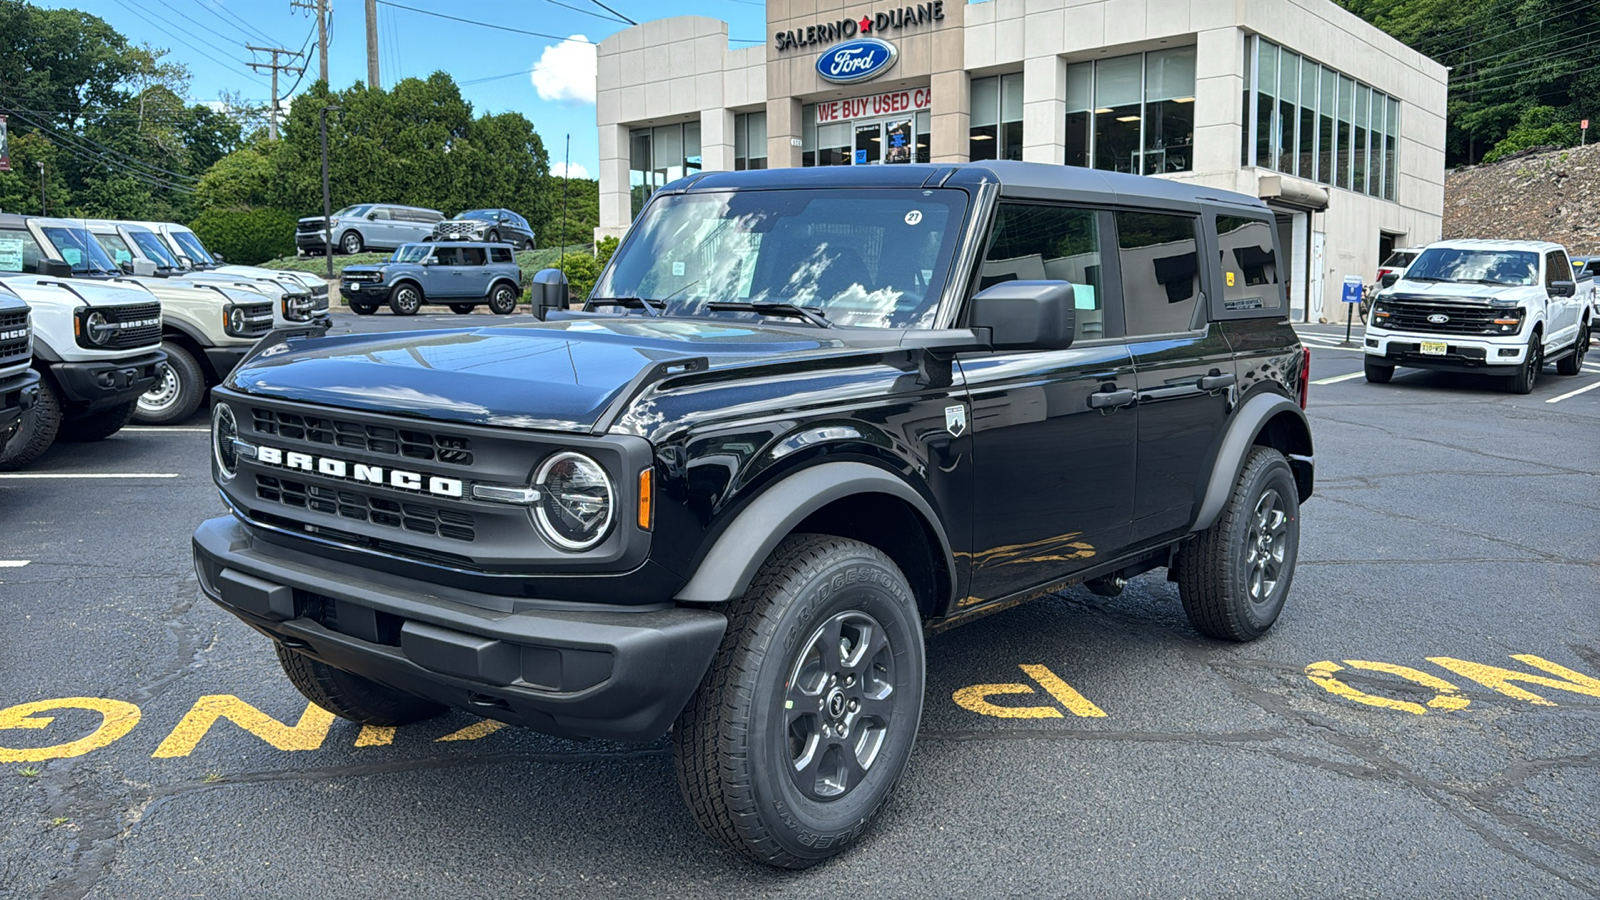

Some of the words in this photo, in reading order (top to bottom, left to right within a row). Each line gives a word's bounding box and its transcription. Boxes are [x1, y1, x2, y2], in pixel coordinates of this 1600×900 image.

[775, 18, 858, 50] SALERNO
[875, 0, 945, 31] DUANE
[830, 47, 874, 75] Ford
[818, 102, 838, 121] WE
[842, 97, 869, 119] BUY
[873, 92, 910, 115] USED
[907, 213, 920, 221] 27
[258, 446, 463, 497] BRONCO
[783, 567, 910, 655] BRIDGESTONE
